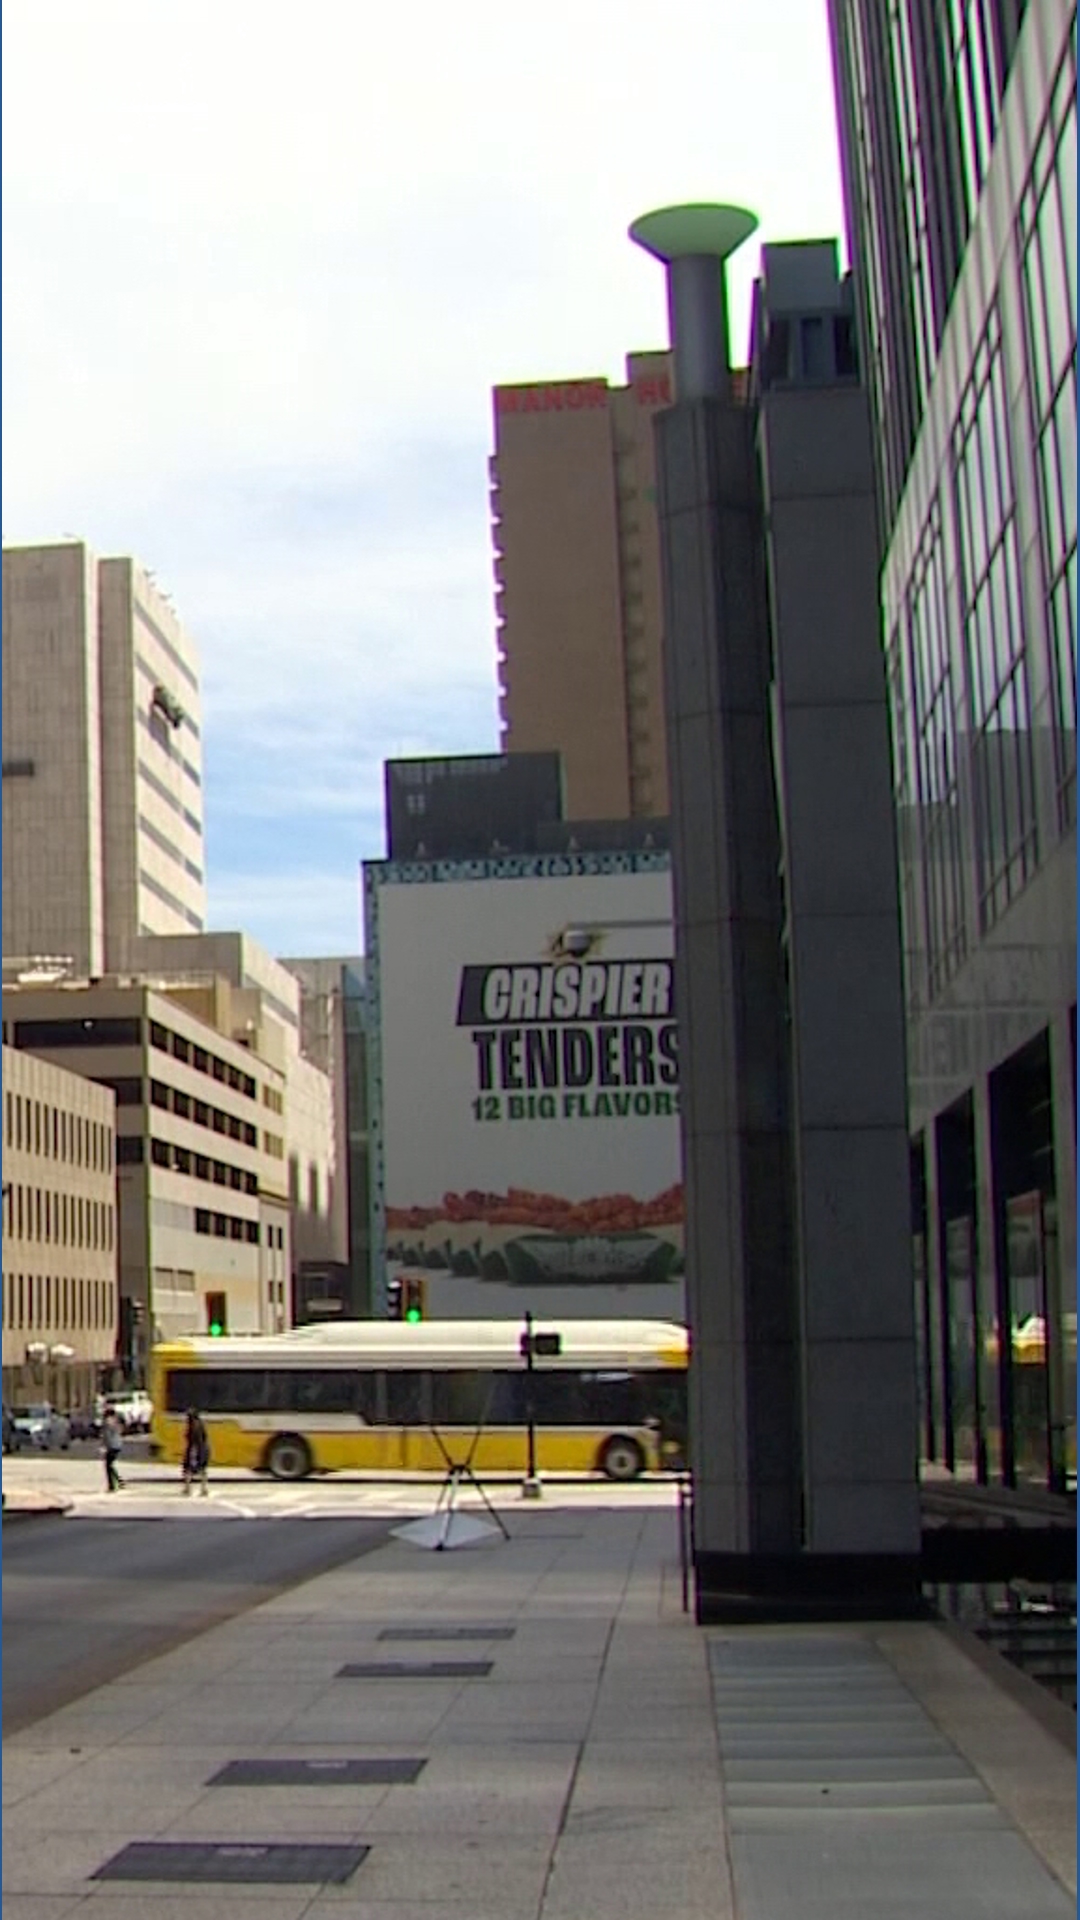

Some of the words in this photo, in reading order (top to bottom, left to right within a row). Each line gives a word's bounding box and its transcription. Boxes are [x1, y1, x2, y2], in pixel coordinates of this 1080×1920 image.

[484, 963, 671, 1020] CRISPIER
[472, 1025, 679, 1090] TENDERS
[472, 1096, 500, 1121] 12
[507, 1094, 556, 1120] BIG
